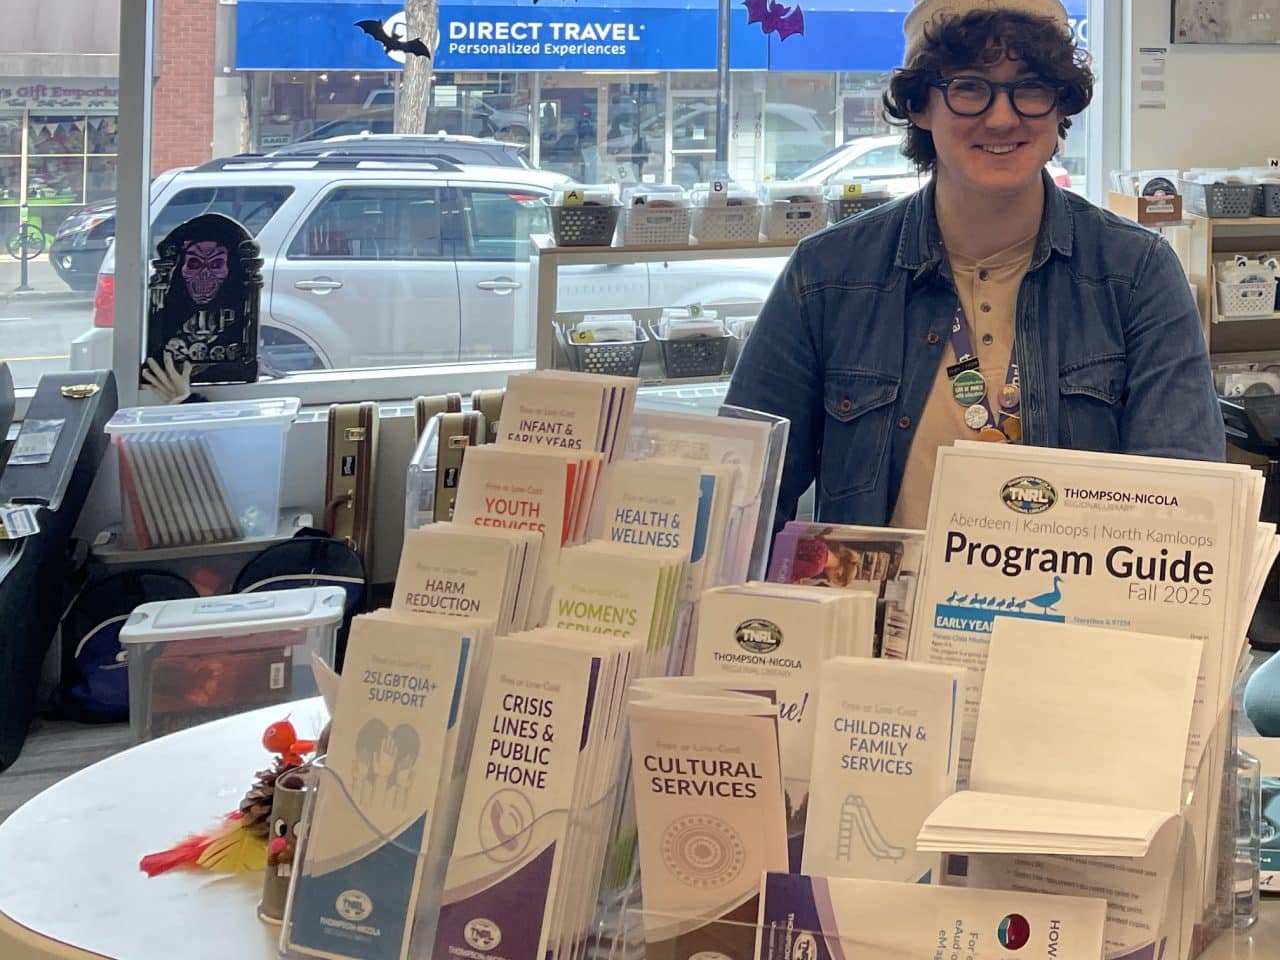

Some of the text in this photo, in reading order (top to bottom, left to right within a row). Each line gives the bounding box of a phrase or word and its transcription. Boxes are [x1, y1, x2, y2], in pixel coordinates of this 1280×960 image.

[449, 21, 641, 41] DIRECT TRAVEL
[449, 42, 627, 57] Personalized Experiences
[16, 84, 48, 100] Gift
[1270, 159, 1279, 167] N
[567, 190, 578, 200] A
[714, 181, 723, 192] B
[519, 420, 573, 435] INFANT &
[485, 496, 540, 518] YOUTH
[1009, 487, 1179, 507] TNRL THOMPSON-NICOLA
[614, 508, 680, 528] HEALTH &
[611, 527, 680, 549] WELLNESS
[950, 512, 1011, 532] Aberdeen
[1023, 519, 1089, 538] Kamloops
[1101, 525, 1142, 542] North
[1146, 529, 1214, 548] Kamloops
[944, 530, 1214, 585] Program Guide
[425, 579, 465, 595] HARM
[1128, 583, 1213, 607] Fall 2025
[406, 592, 481, 613] REDUCTION
[559, 599, 637, 627] WOMEN'S
[936, 615, 968, 630] EARLY
[741, 628, 777, 644] TNRL
[713, 652, 802, 669] THOMPSON-NICOLA
[363, 670, 436, 693] 2SLGBTQIA+
[368, 687, 427, 708] SUPPORT
[502, 693, 553, 718] CRISIS
[492, 715, 554, 742] LINES &
[834, 717, 927, 741] CHILDREN &
[489, 738, 551, 765] PUBLIC
[849, 737, 909, 757] FAMILY
[485, 761, 548, 789] PHONE
[643, 755, 763, 779] CULTURAL
[840, 754, 913, 776] SERVICES
[651, 777, 757, 799] SERVICES
[967, 932, 979, 952] For
